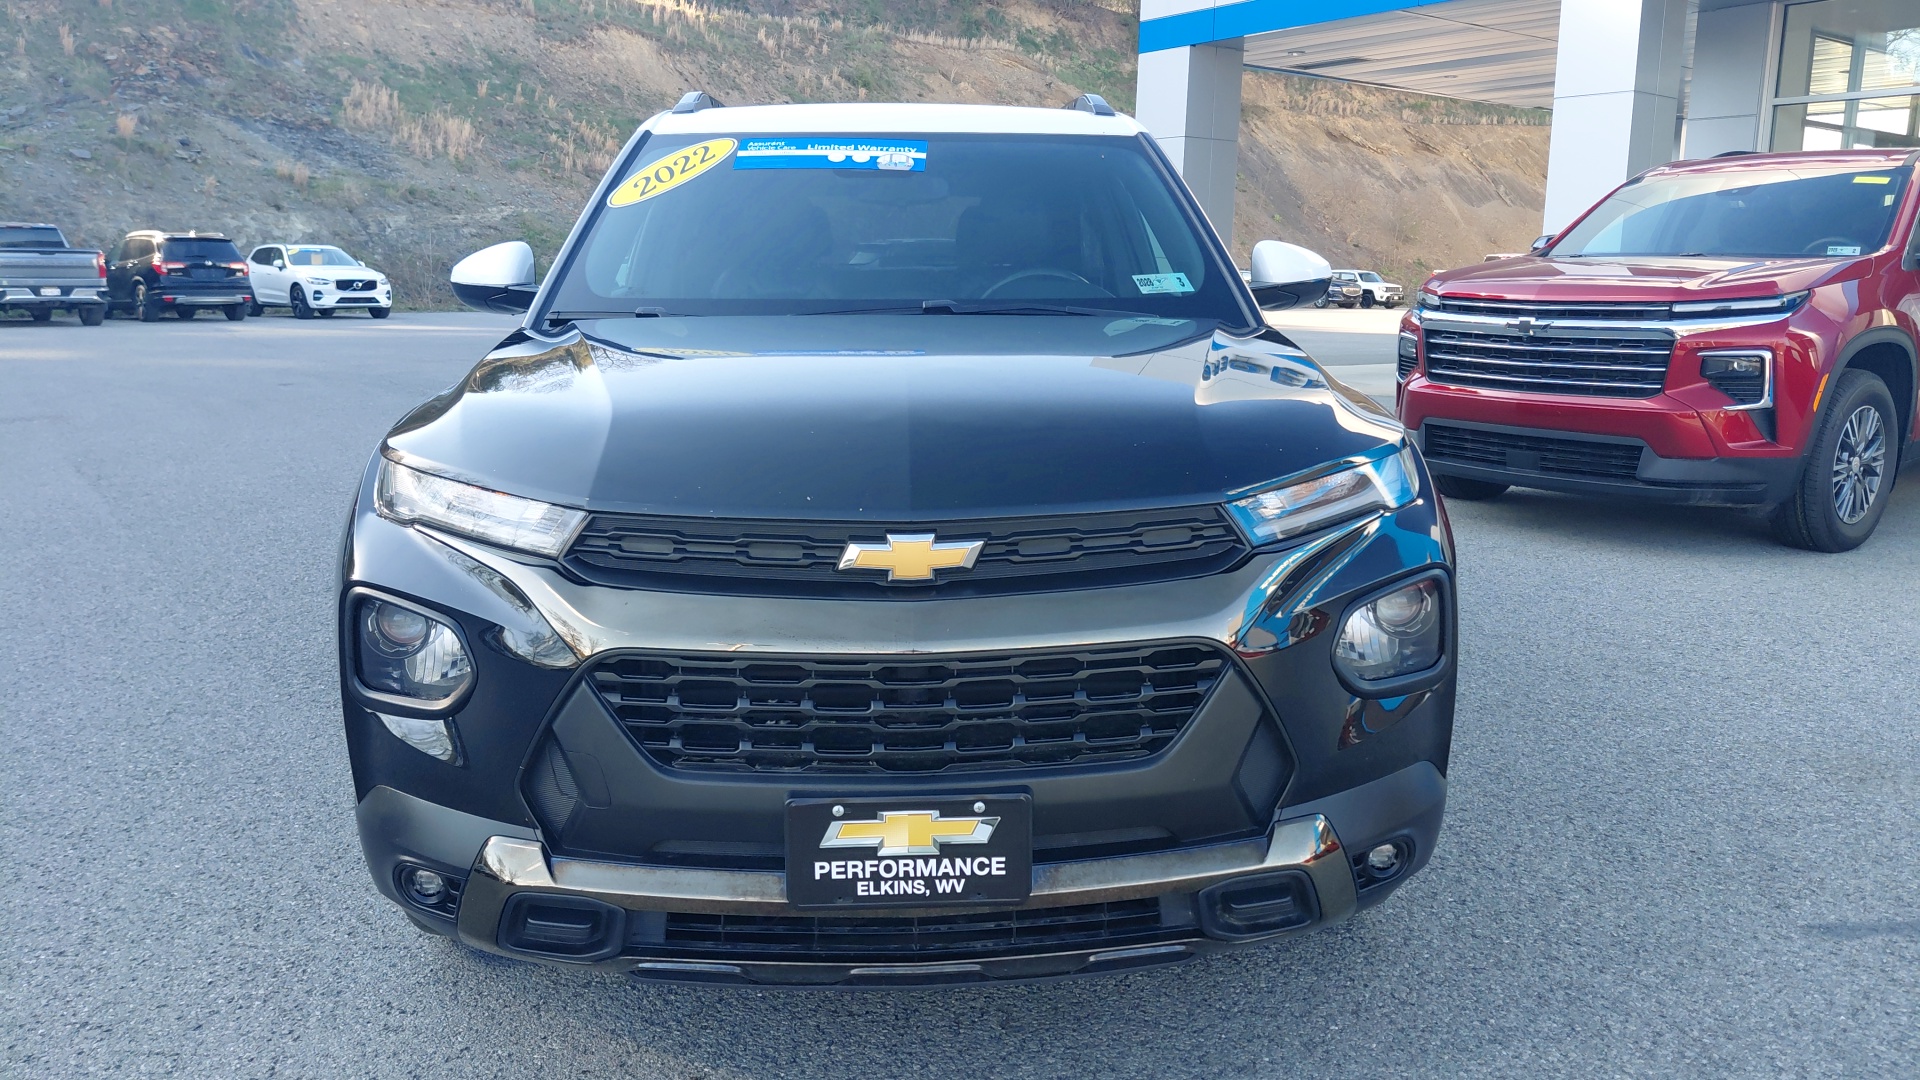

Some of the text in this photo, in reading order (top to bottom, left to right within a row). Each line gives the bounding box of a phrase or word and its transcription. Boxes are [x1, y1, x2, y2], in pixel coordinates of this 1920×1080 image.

[807, 143, 917, 154] Limited Warranty
[633, 145, 716, 197] 2022
[1175, 276, 1186, 288] 3
[813, 857, 1006, 880] PERFORMANCE
[857, 878, 966, 897] ELKINS, WV
